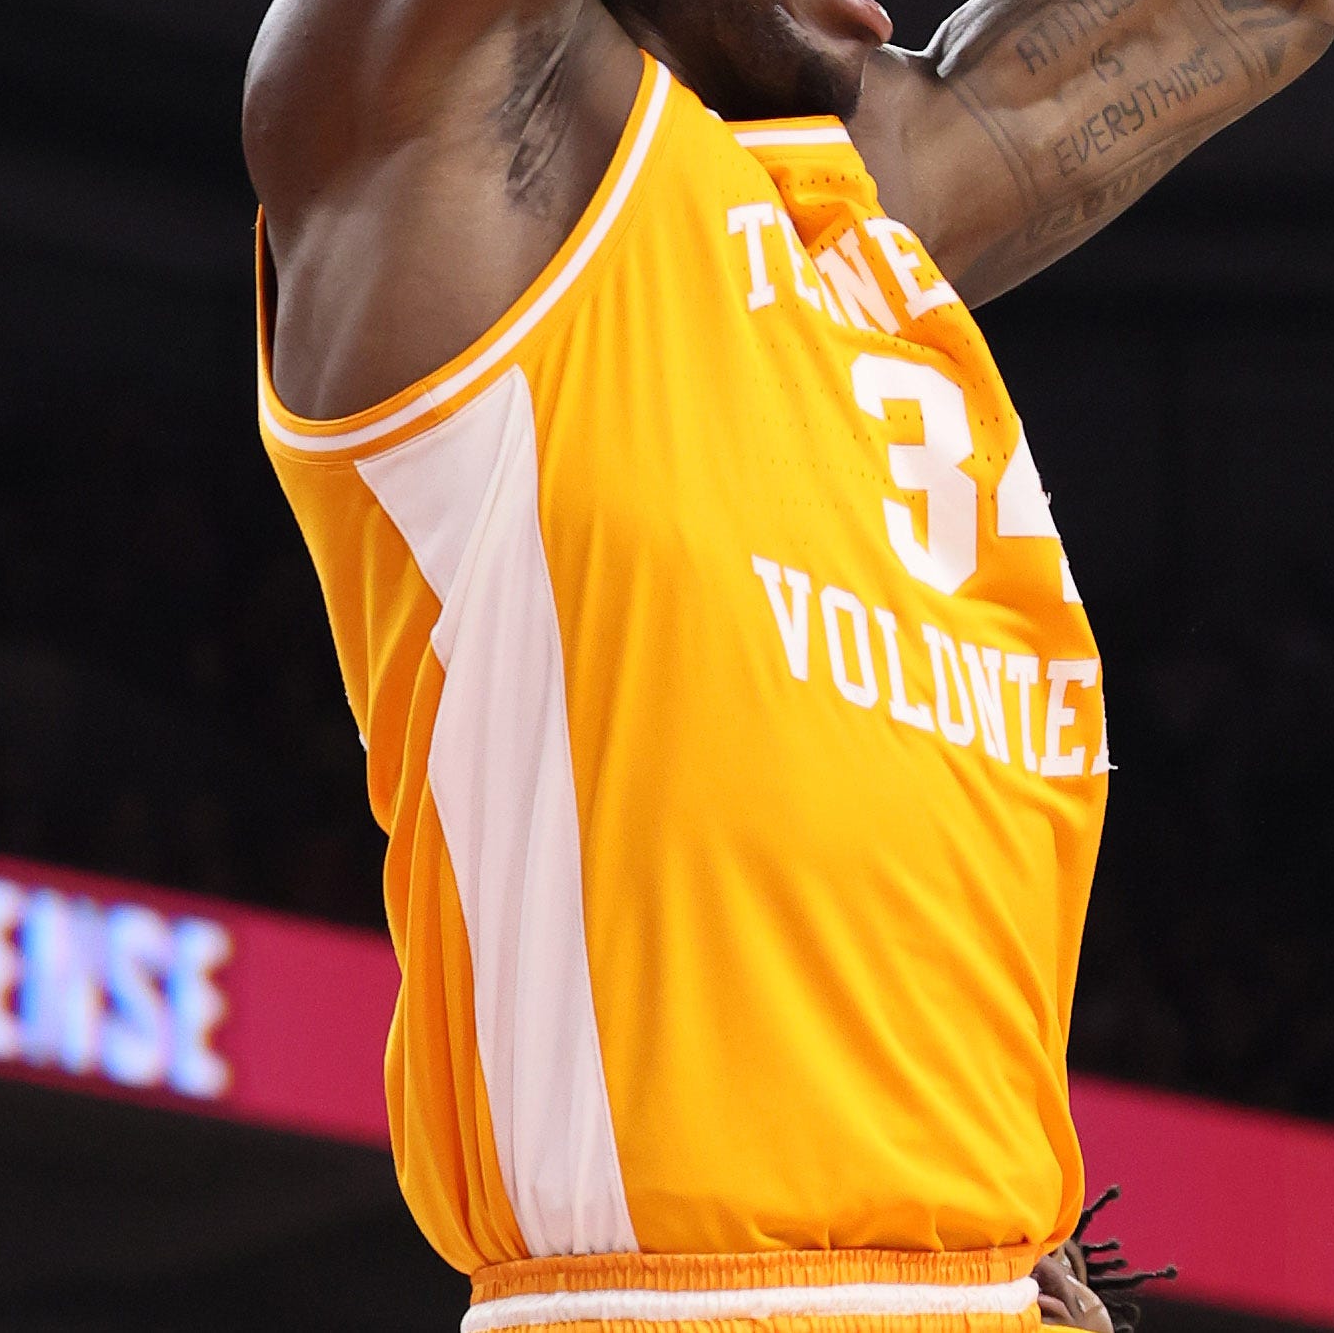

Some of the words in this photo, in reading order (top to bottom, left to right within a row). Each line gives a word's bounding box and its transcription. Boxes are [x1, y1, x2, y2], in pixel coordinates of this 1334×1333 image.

[1053, 45, 1224, 178] EVERYTHING
[1091, 40, 1124, 84] IS
[751, 555, 1112, 777] VOLUNTE
